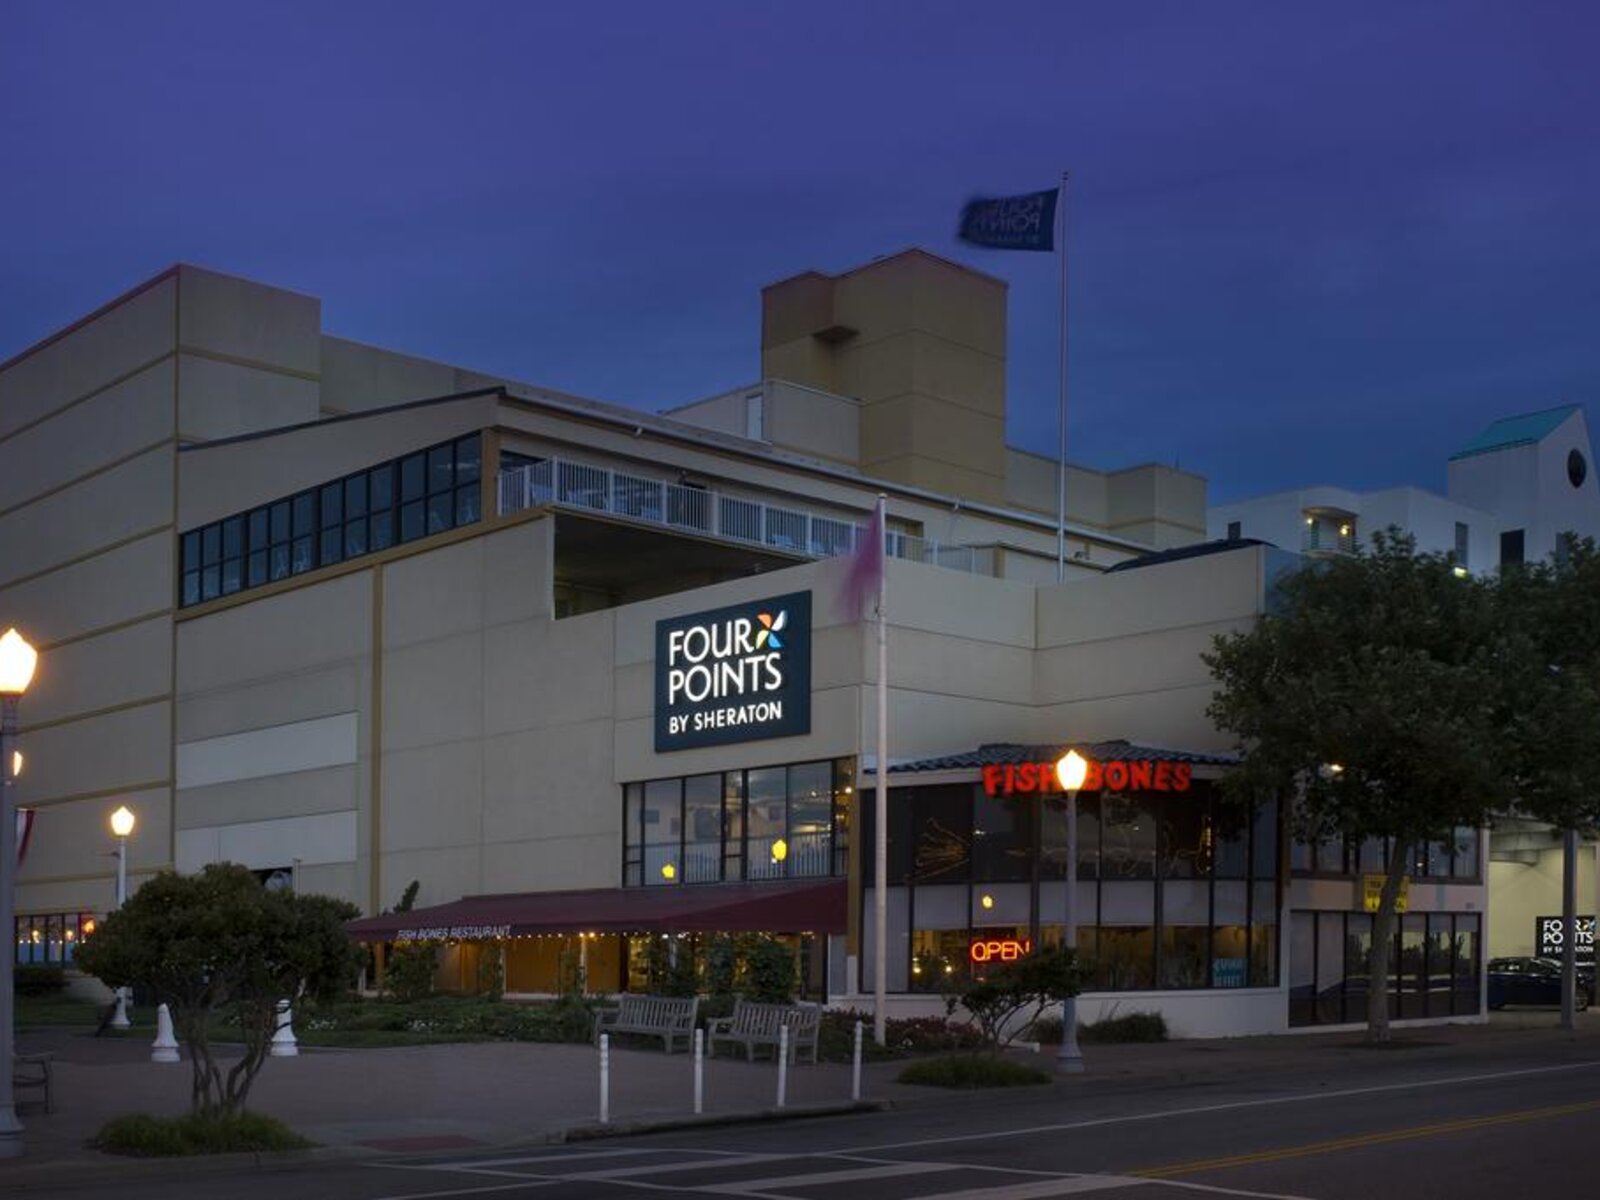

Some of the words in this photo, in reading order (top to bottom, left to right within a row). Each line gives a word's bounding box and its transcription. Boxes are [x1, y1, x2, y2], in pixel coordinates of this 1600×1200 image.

[669, 618, 754, 666] FOUR
[669, 653, 782, 705] POINTS
[669, 715, 690, 734] BY
[694, 701, 782, 731] SHERATON
[981, 761, 1062, 797] FISH
[1081, 760, 1192, 792] BONES
[1543, 920, 1583, 932] FOR
[1543, 932, 1593, 944] POTS
[971, 941, 1030, 961] OPEN
